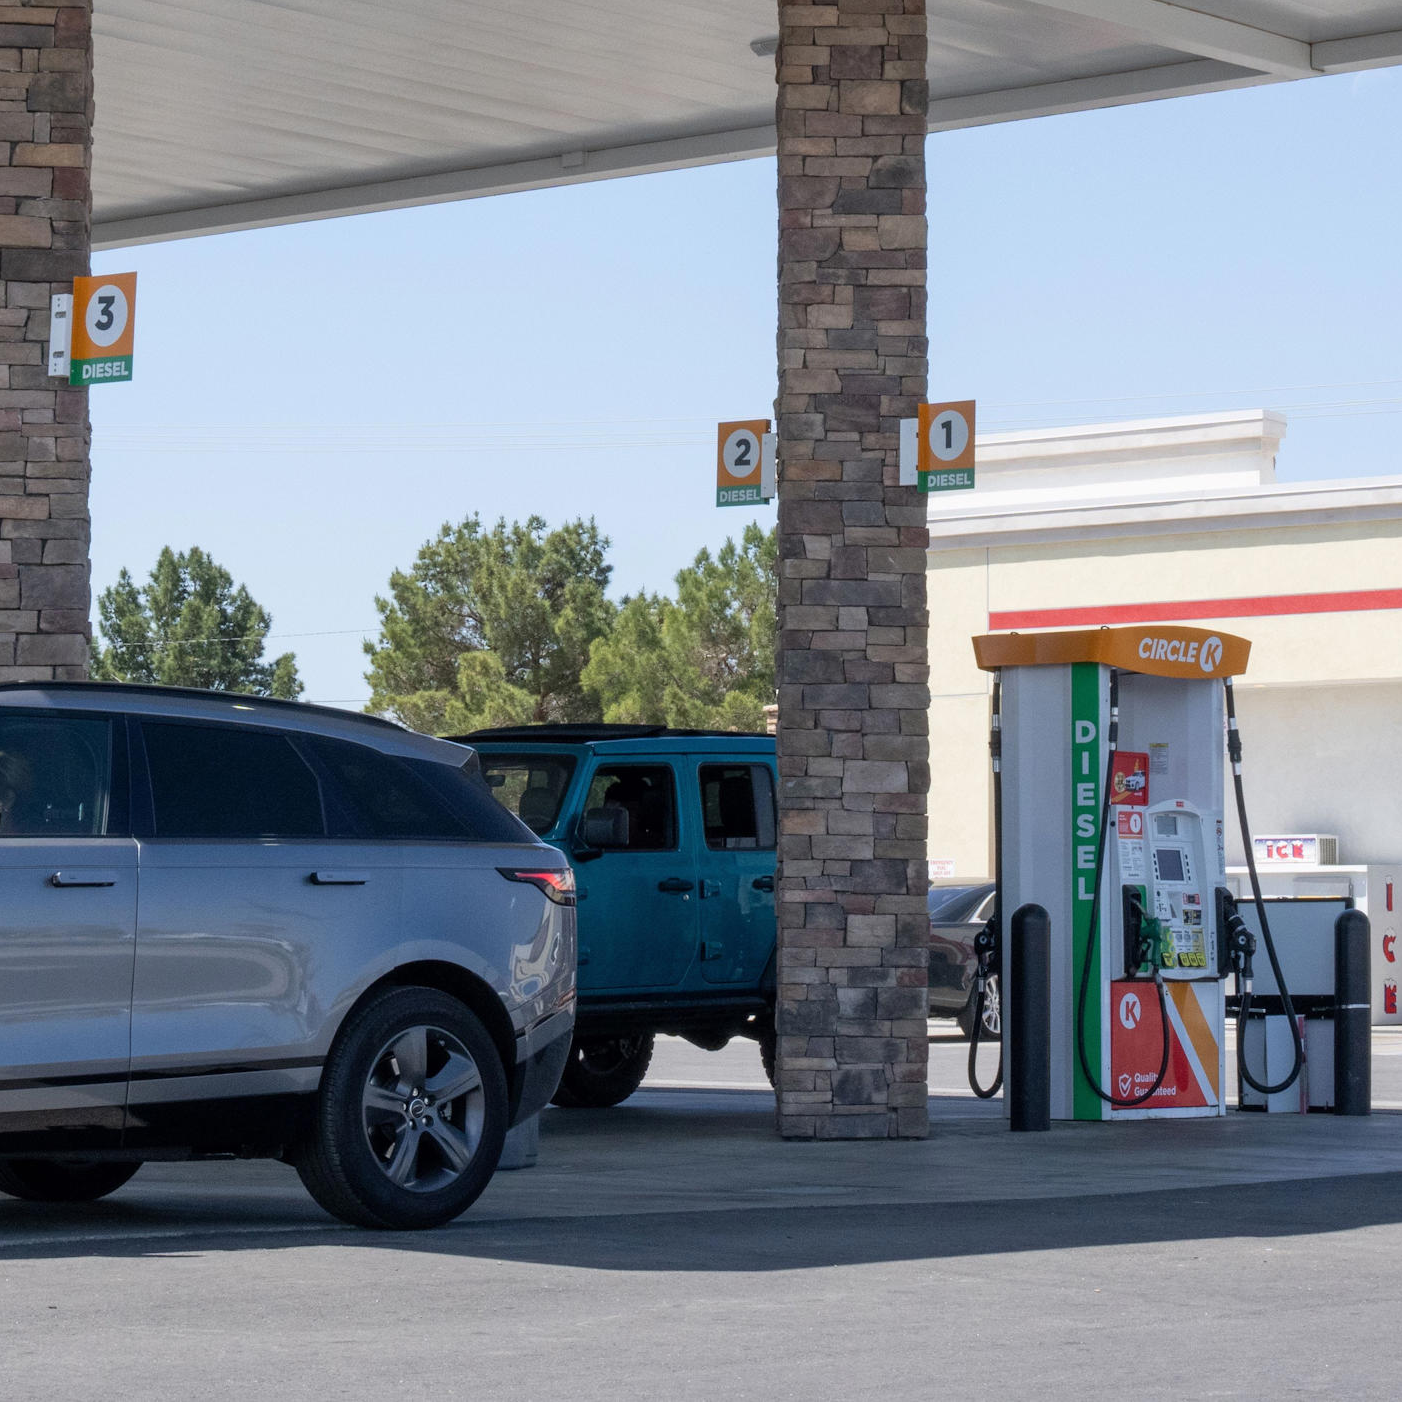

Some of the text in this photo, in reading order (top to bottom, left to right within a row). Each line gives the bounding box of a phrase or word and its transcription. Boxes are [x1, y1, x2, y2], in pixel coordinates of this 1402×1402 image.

[94, 295, 116, 331] 3
[82, 361, 129, 379] DIESEL
[940, 419, 953, 449] 1
[734, 438, 752, 466] 2
[928, 473, 971, 488] DIESEL
[719, 488, 760, 503] DIESEL
[1138, 637, 1199, 663] CIRCLE
[1075, 720, 1097, 901] DIESEL
[1133, 819, 1138, 828] 1
[1266, 841, 1304, 859] ICE
[1134, 1071, 1159, 1083] Qualit
